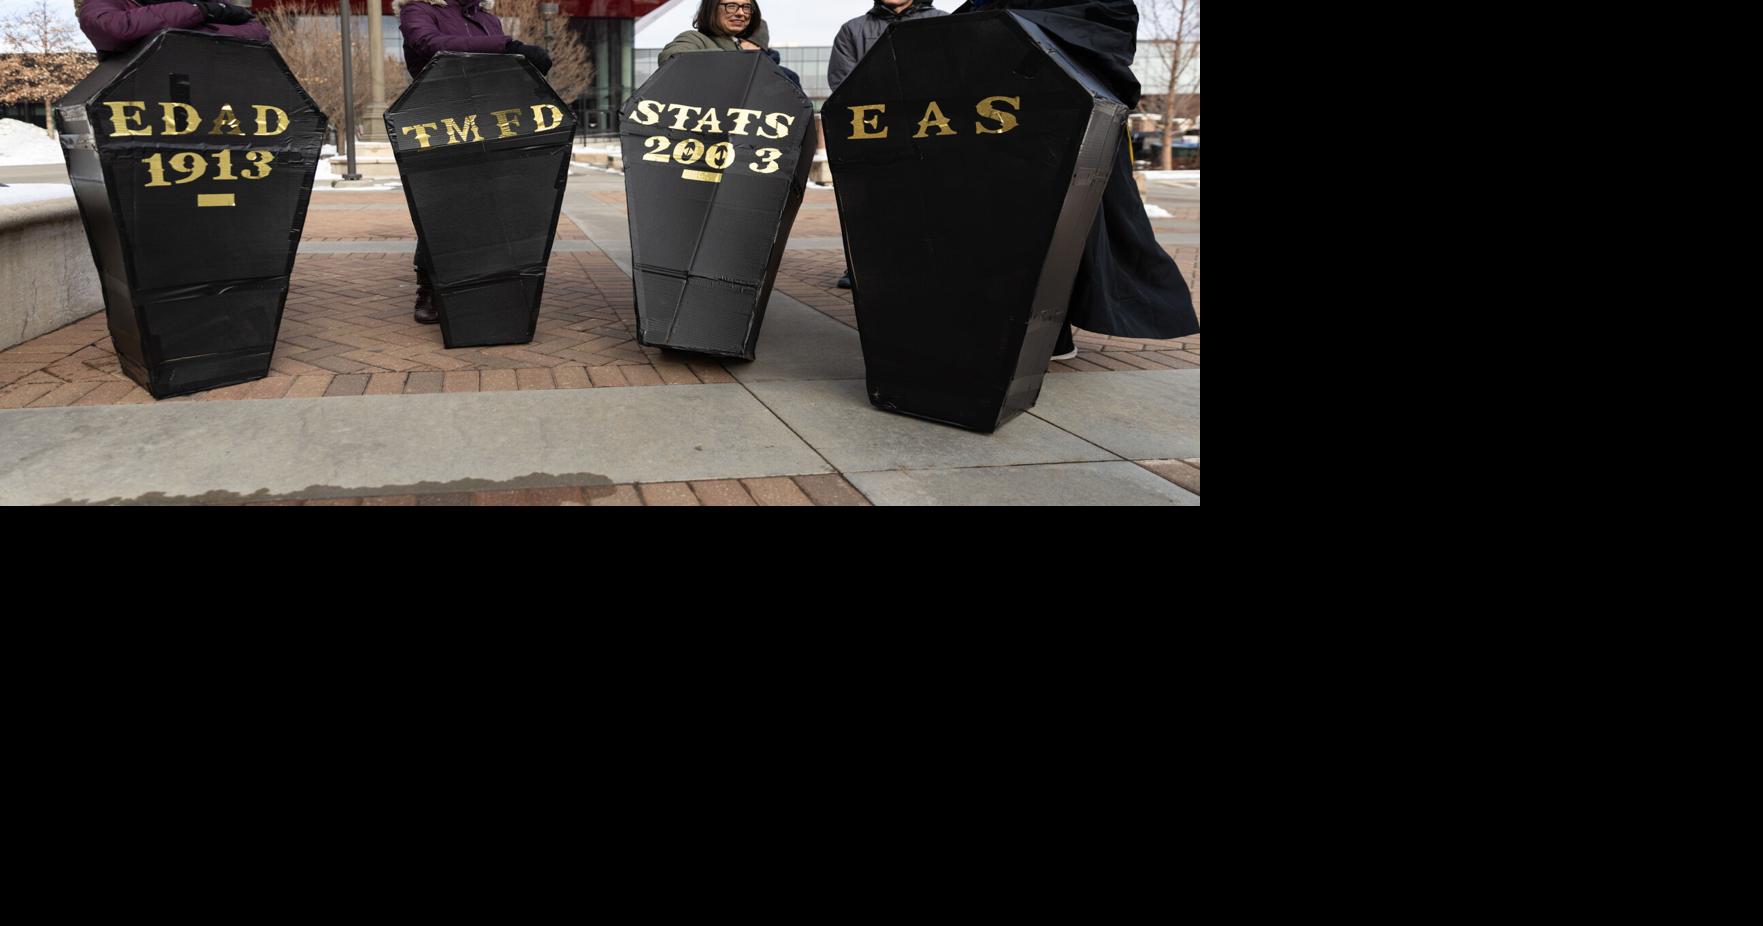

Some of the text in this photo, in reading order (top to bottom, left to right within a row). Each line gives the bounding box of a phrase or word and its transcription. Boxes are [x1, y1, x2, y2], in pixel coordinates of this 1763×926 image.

[103, 101, 290, 137] EDAD
[401, 103, 564, 151] TMFD
[628, 99, 795, 139] STATS
[847, 95, 1020, 140] EAS
[141, 149, 275, 187] 1913
[642, 135, 783, 174] 2003
